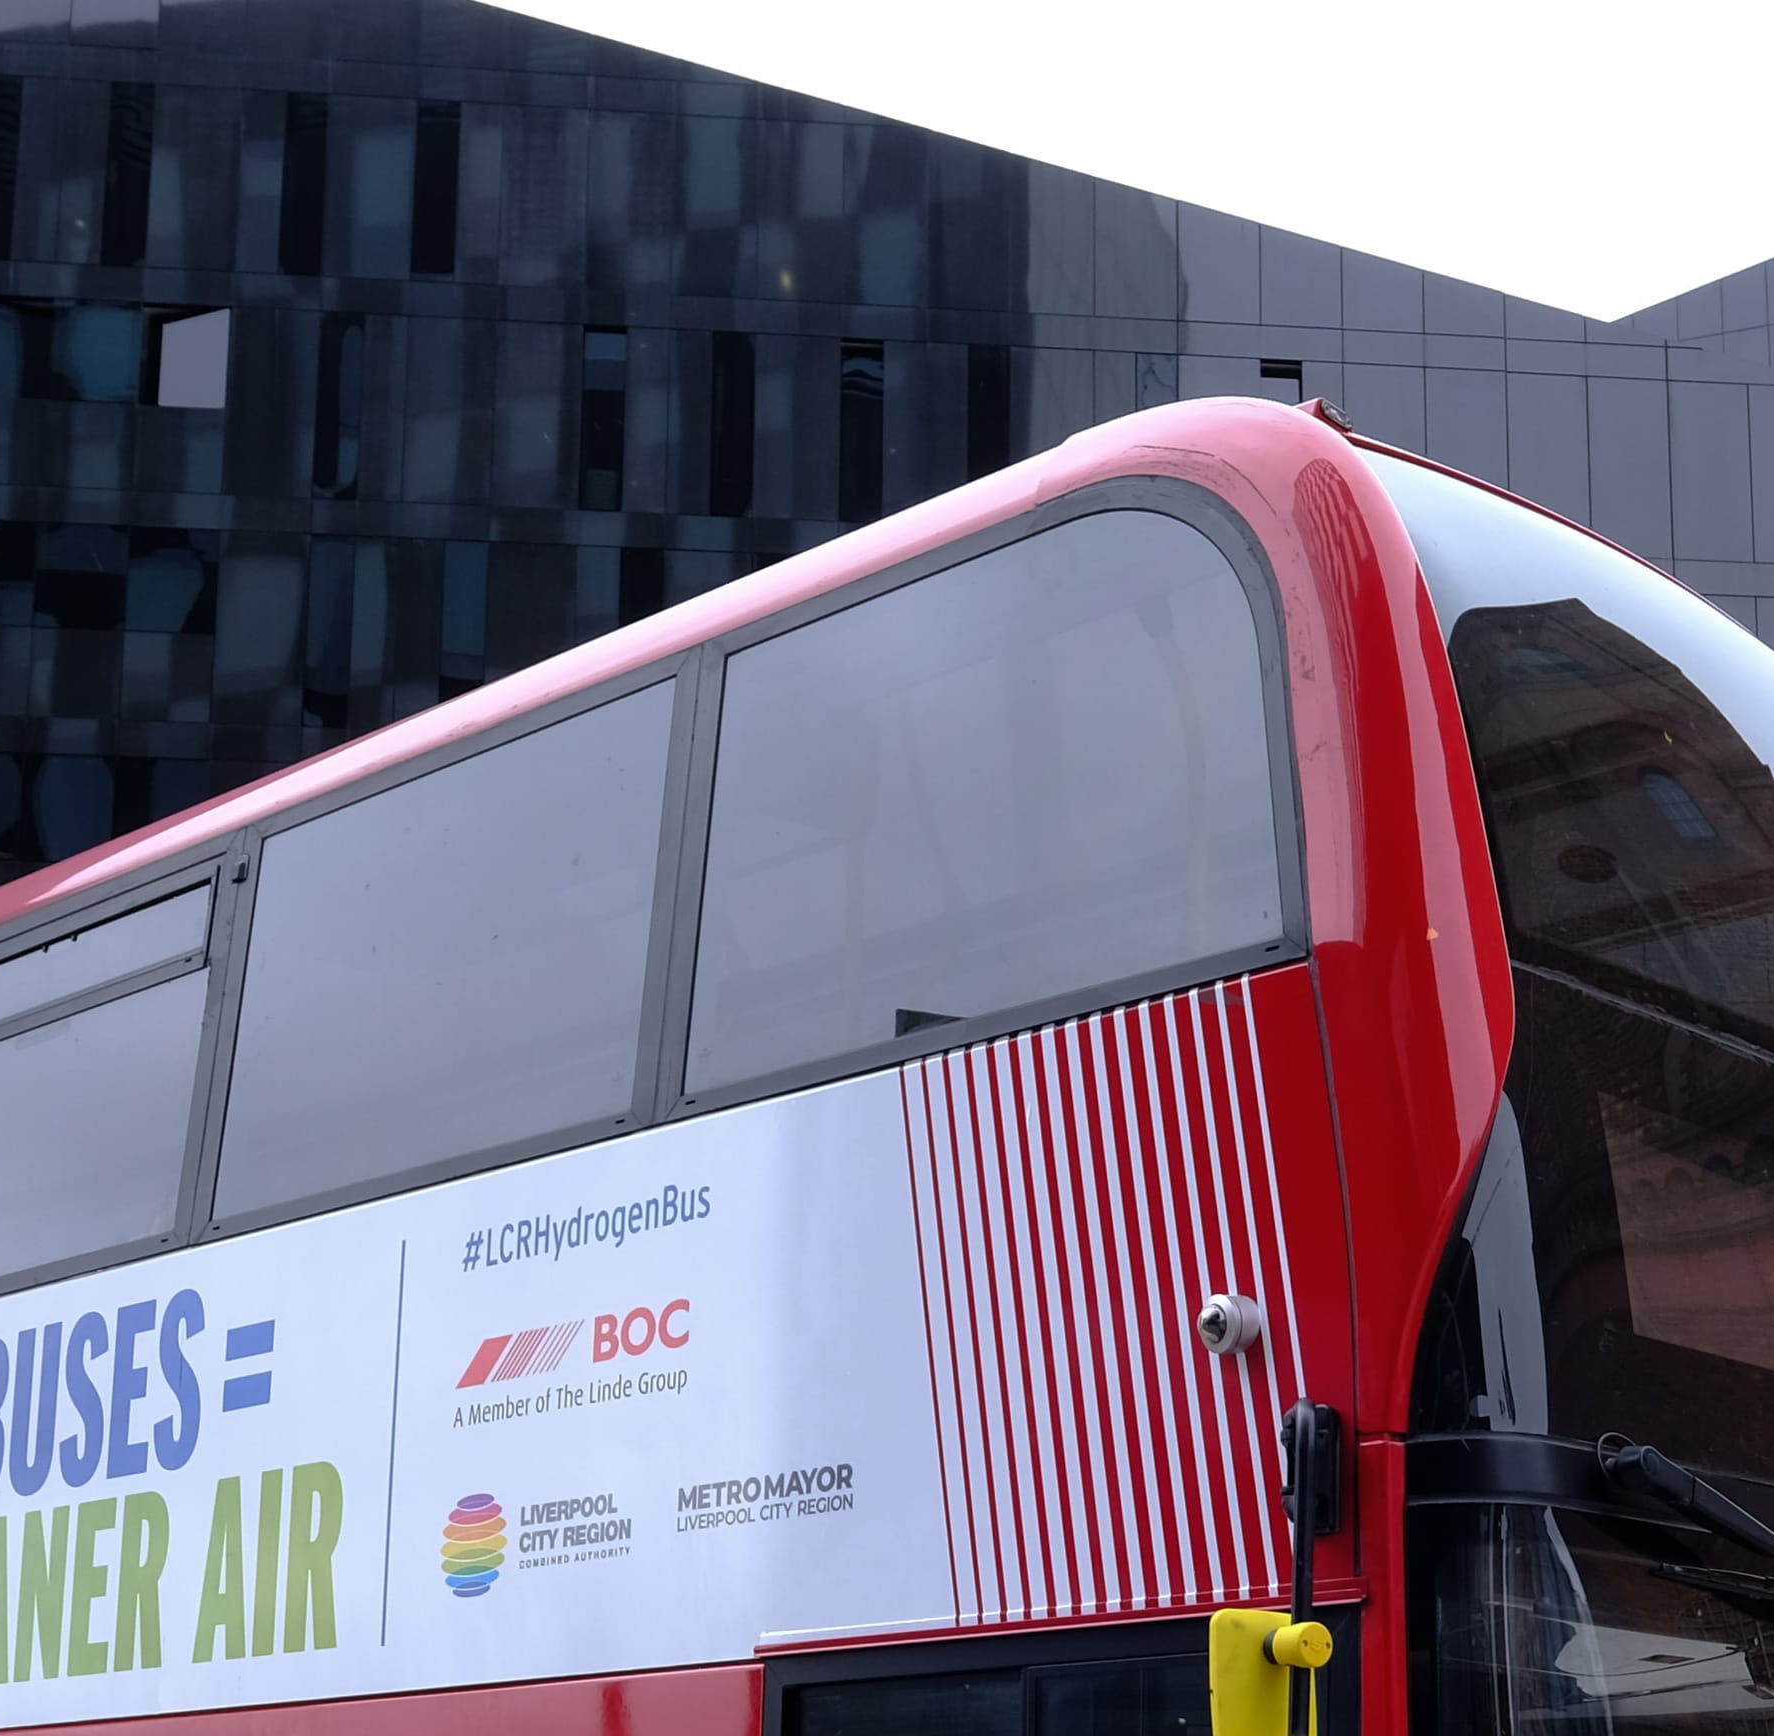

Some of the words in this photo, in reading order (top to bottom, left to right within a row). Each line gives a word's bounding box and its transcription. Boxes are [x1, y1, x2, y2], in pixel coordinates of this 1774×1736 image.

[463, 1184, 710, 1272] #LCRHydrogenBus
[592, 1298, 690, 1364] BOC
[453, 1407, 465, 1429] A
[468, 1395, 530, 1426] Member
[535, 1387, 552, 1413] of
[555, 1383, 584, 1409] The
[589, 1374, 633, 1405] Linde
[638, 1369, 689, 1396] Group
[521, 1493, 617, 1526] LIVERPOOL
[677, 1506, 755, 1532] LIVERPOOL
[760, 1502, 793, 1522] CITY
[797, 1493, 854, 1517] REGION
[519, 1526, 559, 1554] CITY
[563, 1519, 631, 1547] REGION
[519, 1555, 570, 1569] COMBINED
[574, 1546, 631, 1562] AUTHORITY
[192, 1461, 344, 1664] AIR
